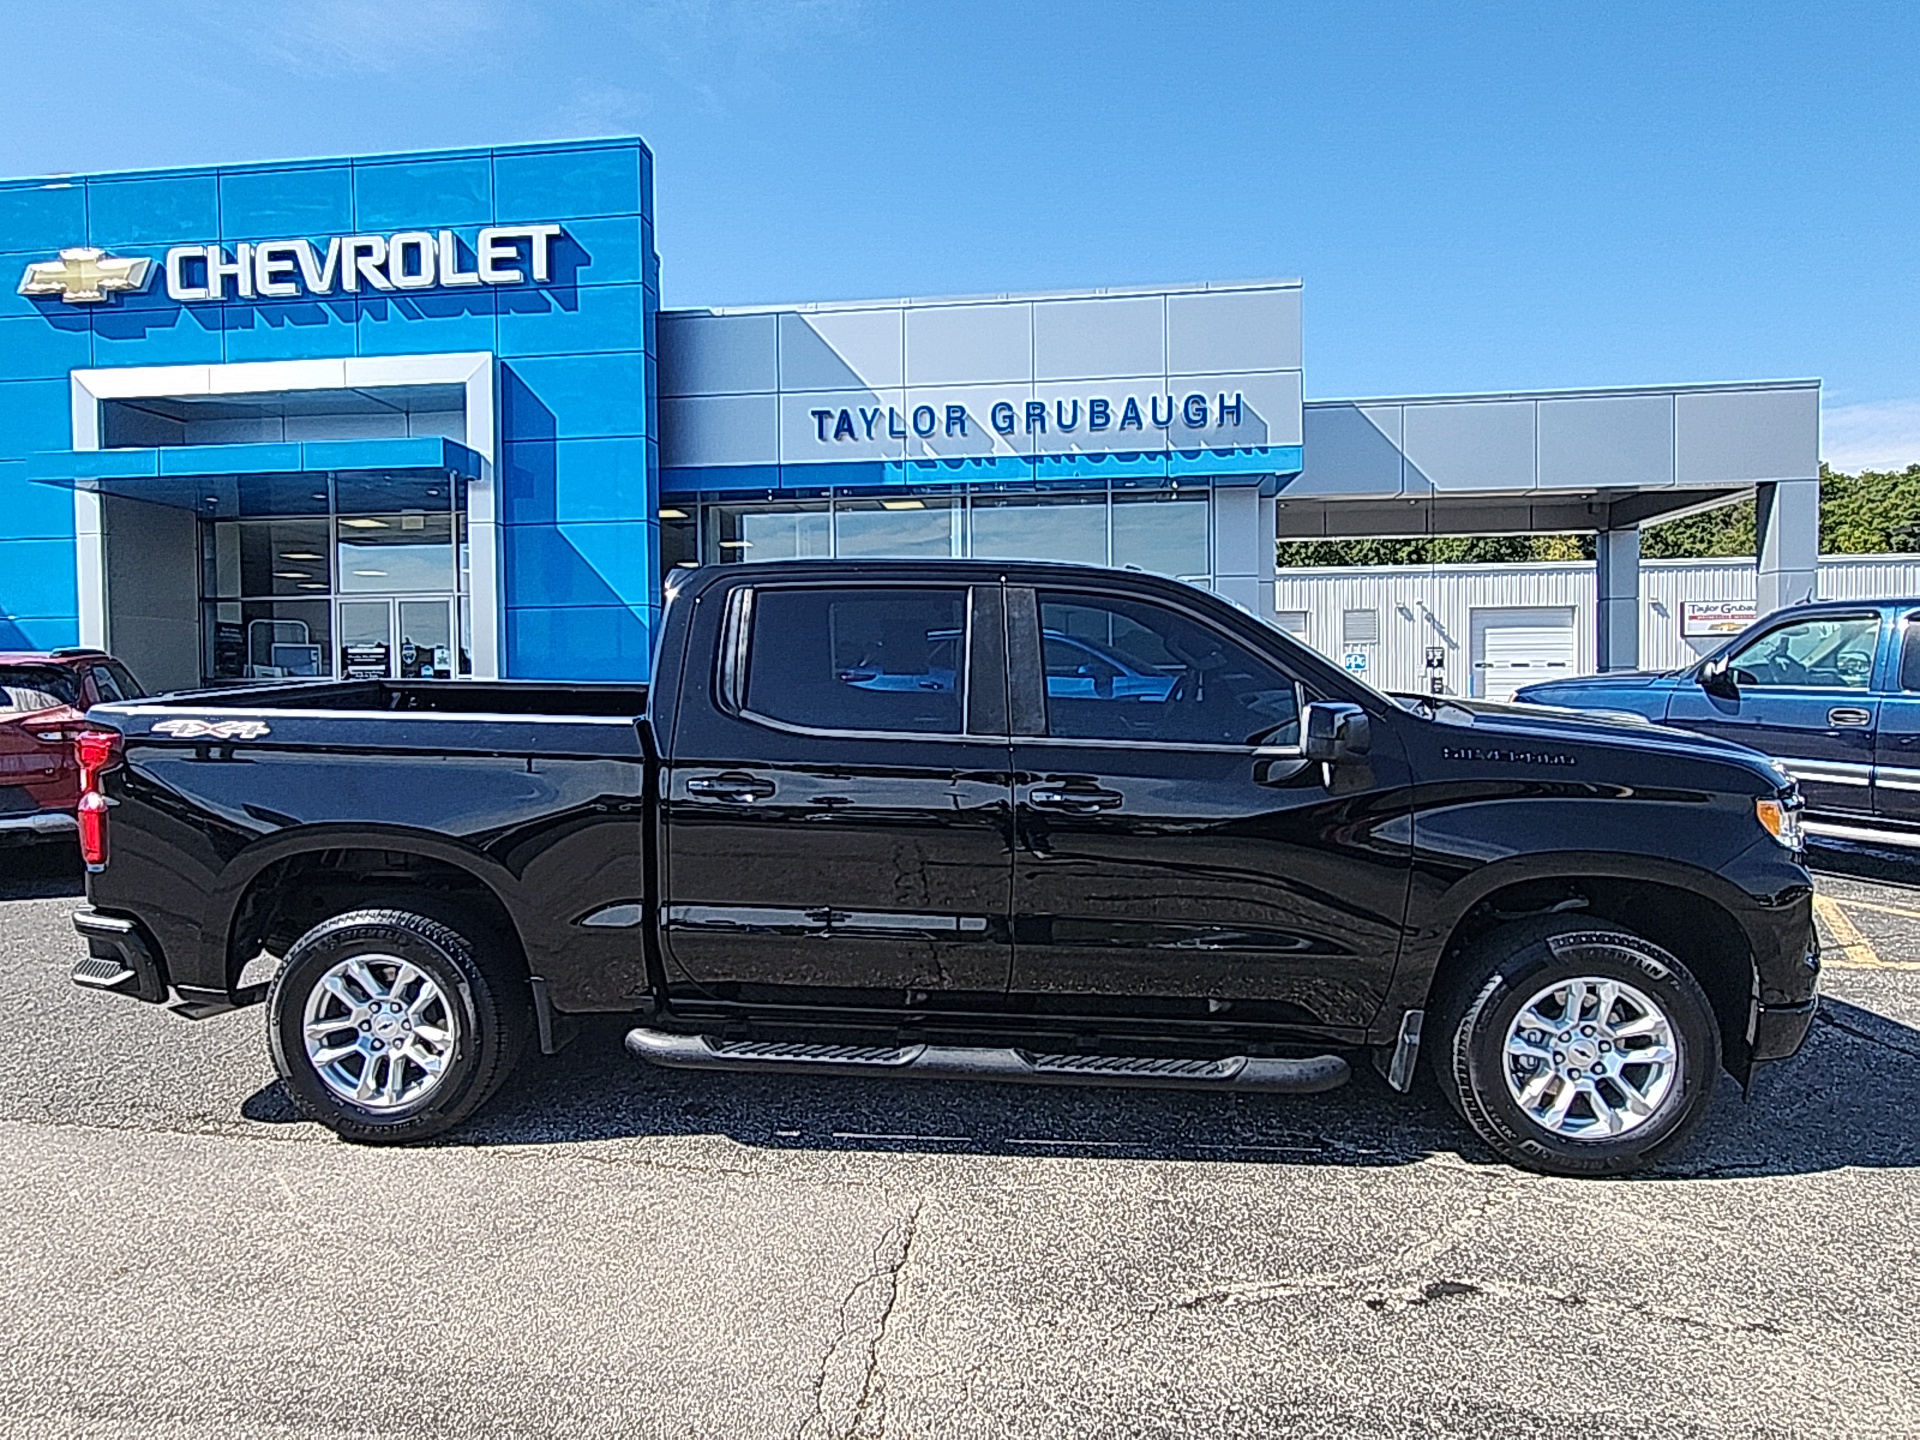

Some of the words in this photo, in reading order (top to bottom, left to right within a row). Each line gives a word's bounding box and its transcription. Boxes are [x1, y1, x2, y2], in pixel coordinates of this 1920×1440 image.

[166, 223, 560, 300] CHEVROLET
[810, 403, 968, 440] TAYLOR
[990, 393, 1243, 434] GRUBAUGH
[1688, 604, 1719, 614] Taylor
